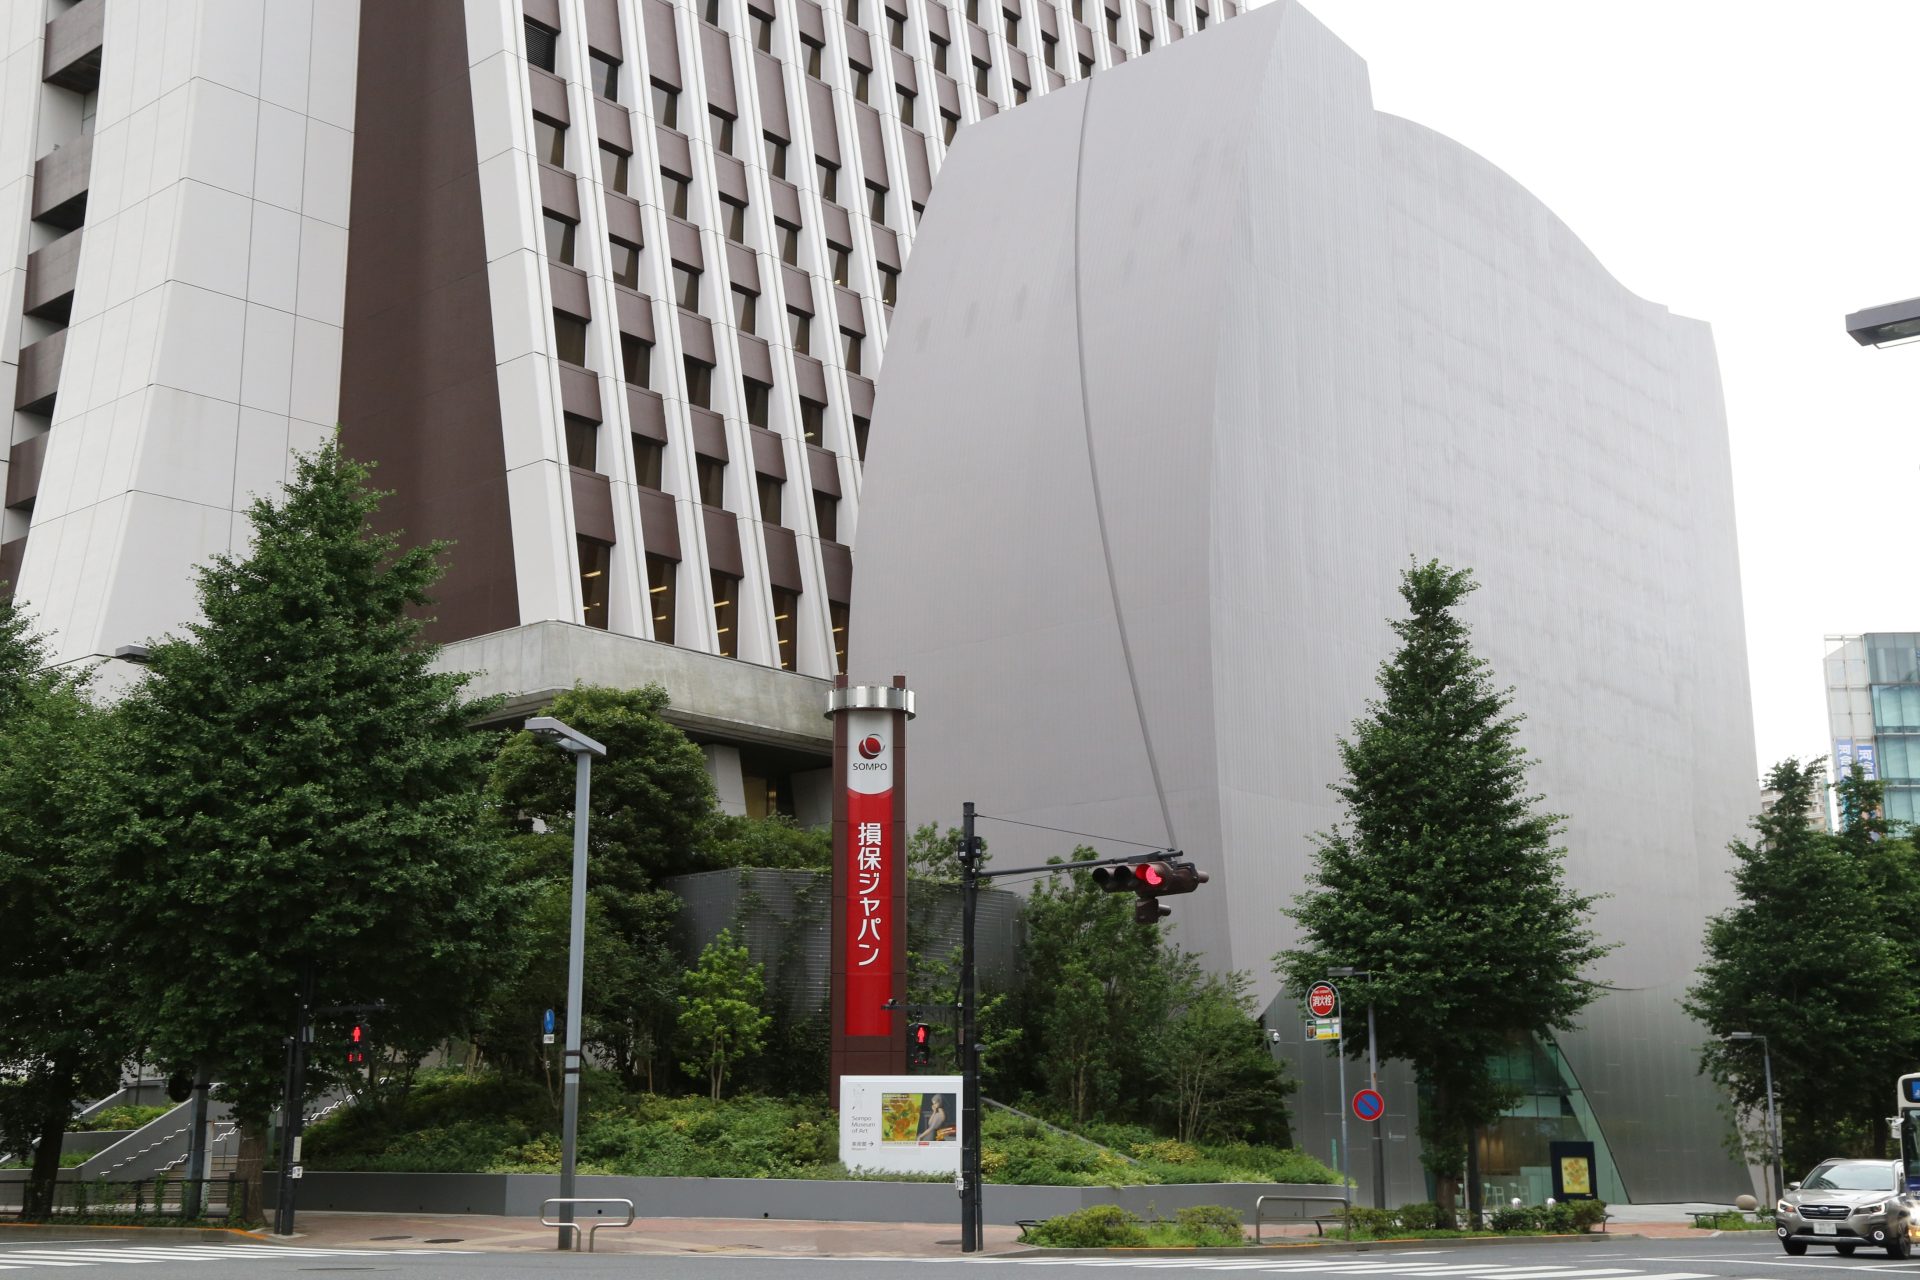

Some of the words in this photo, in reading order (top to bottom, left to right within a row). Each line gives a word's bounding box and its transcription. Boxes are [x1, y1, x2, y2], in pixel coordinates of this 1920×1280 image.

[852, 762, 888, 771] SOMPO
[857, 822, 882, 967] 損保ジャパン
[1313, 995, 1332, 1006] 消火栓
